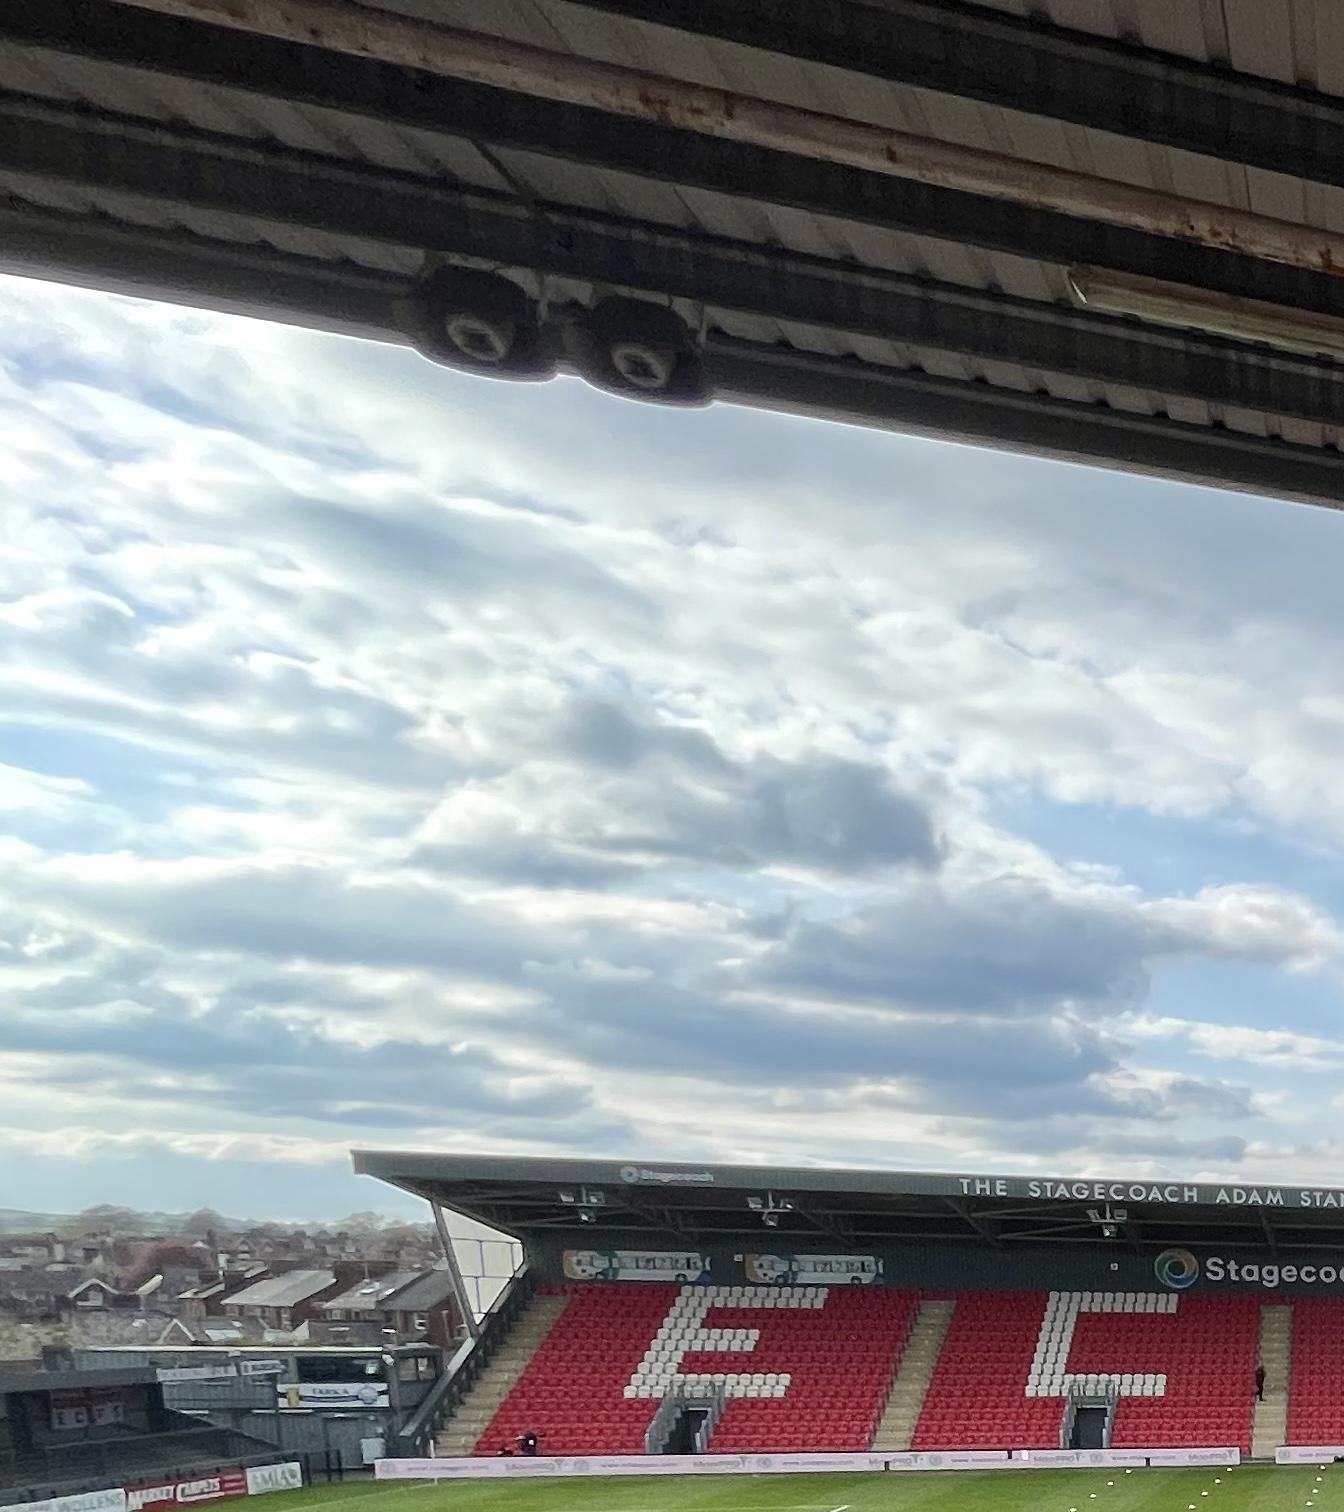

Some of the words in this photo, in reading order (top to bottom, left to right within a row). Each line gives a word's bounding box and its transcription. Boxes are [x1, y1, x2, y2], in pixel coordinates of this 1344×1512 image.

[959, 1178, 1008, 1197] THE
[1028, 1179, 1199, 1204] STAGECOACH
[1215, 1187, 1285, 1206] ADAM
[623, 1285, 829, 1398] E
[1025, 1290, 1178, 1397] C
